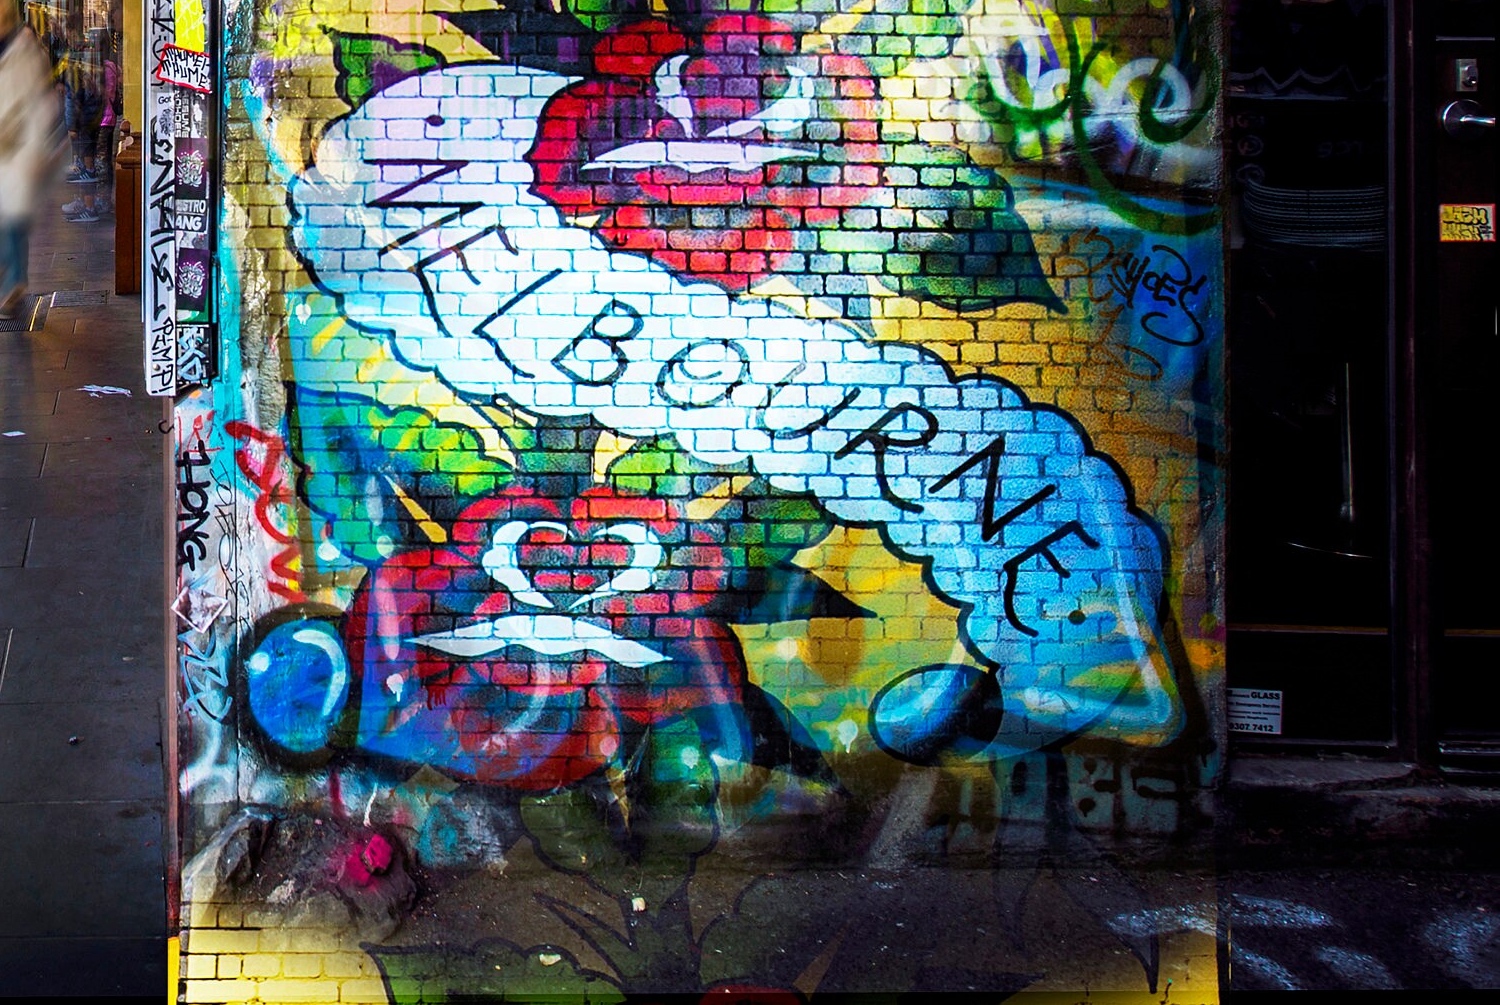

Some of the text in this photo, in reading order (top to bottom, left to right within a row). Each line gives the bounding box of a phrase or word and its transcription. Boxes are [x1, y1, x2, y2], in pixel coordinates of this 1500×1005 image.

[368, 154, 1100, 639] MELBOURNE
[1251, 691, 1280, 700] GLASS
[1252, 724, 1274, 732] 7412
